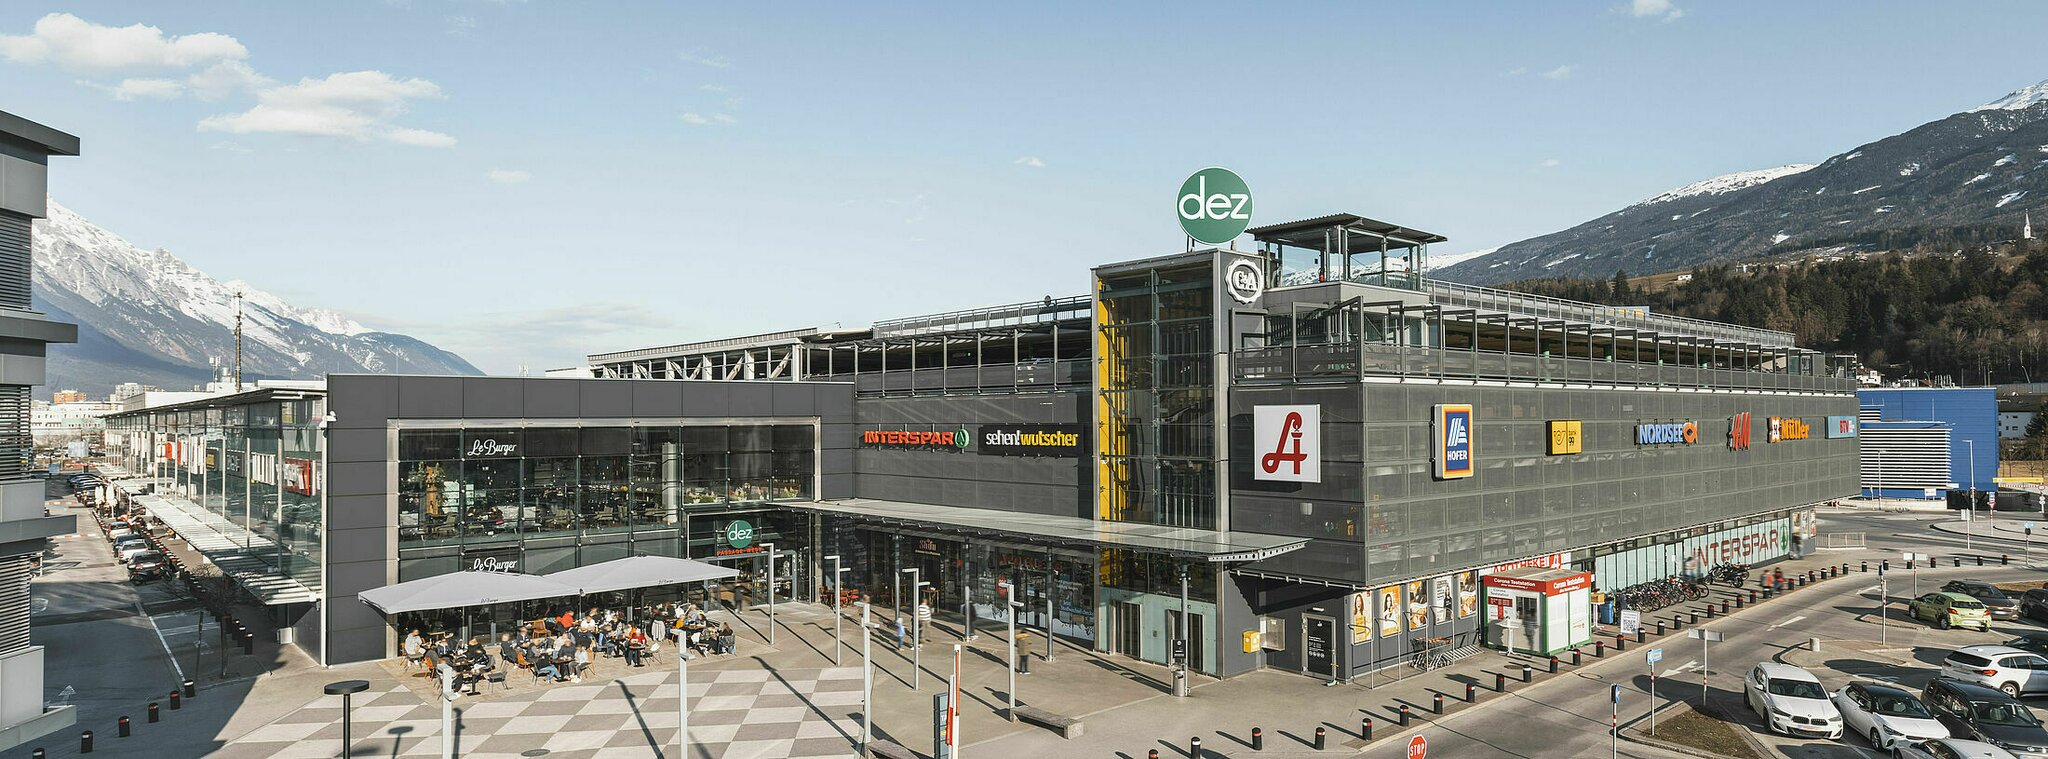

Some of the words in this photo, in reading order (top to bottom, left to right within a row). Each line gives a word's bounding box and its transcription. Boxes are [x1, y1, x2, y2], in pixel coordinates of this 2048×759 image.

[1178, 176, 1249, 220] dez
[864, 430, 954, 445] INTERSPAR
[1640, 423, 1683, 444] NORDSEE
[1780, 418, 1809, 439] Müller
[1447, 450, 1468, 461] HOFER
[728, 523, 753, 541] dez
[1410, 743, 1425, 756] STOP
